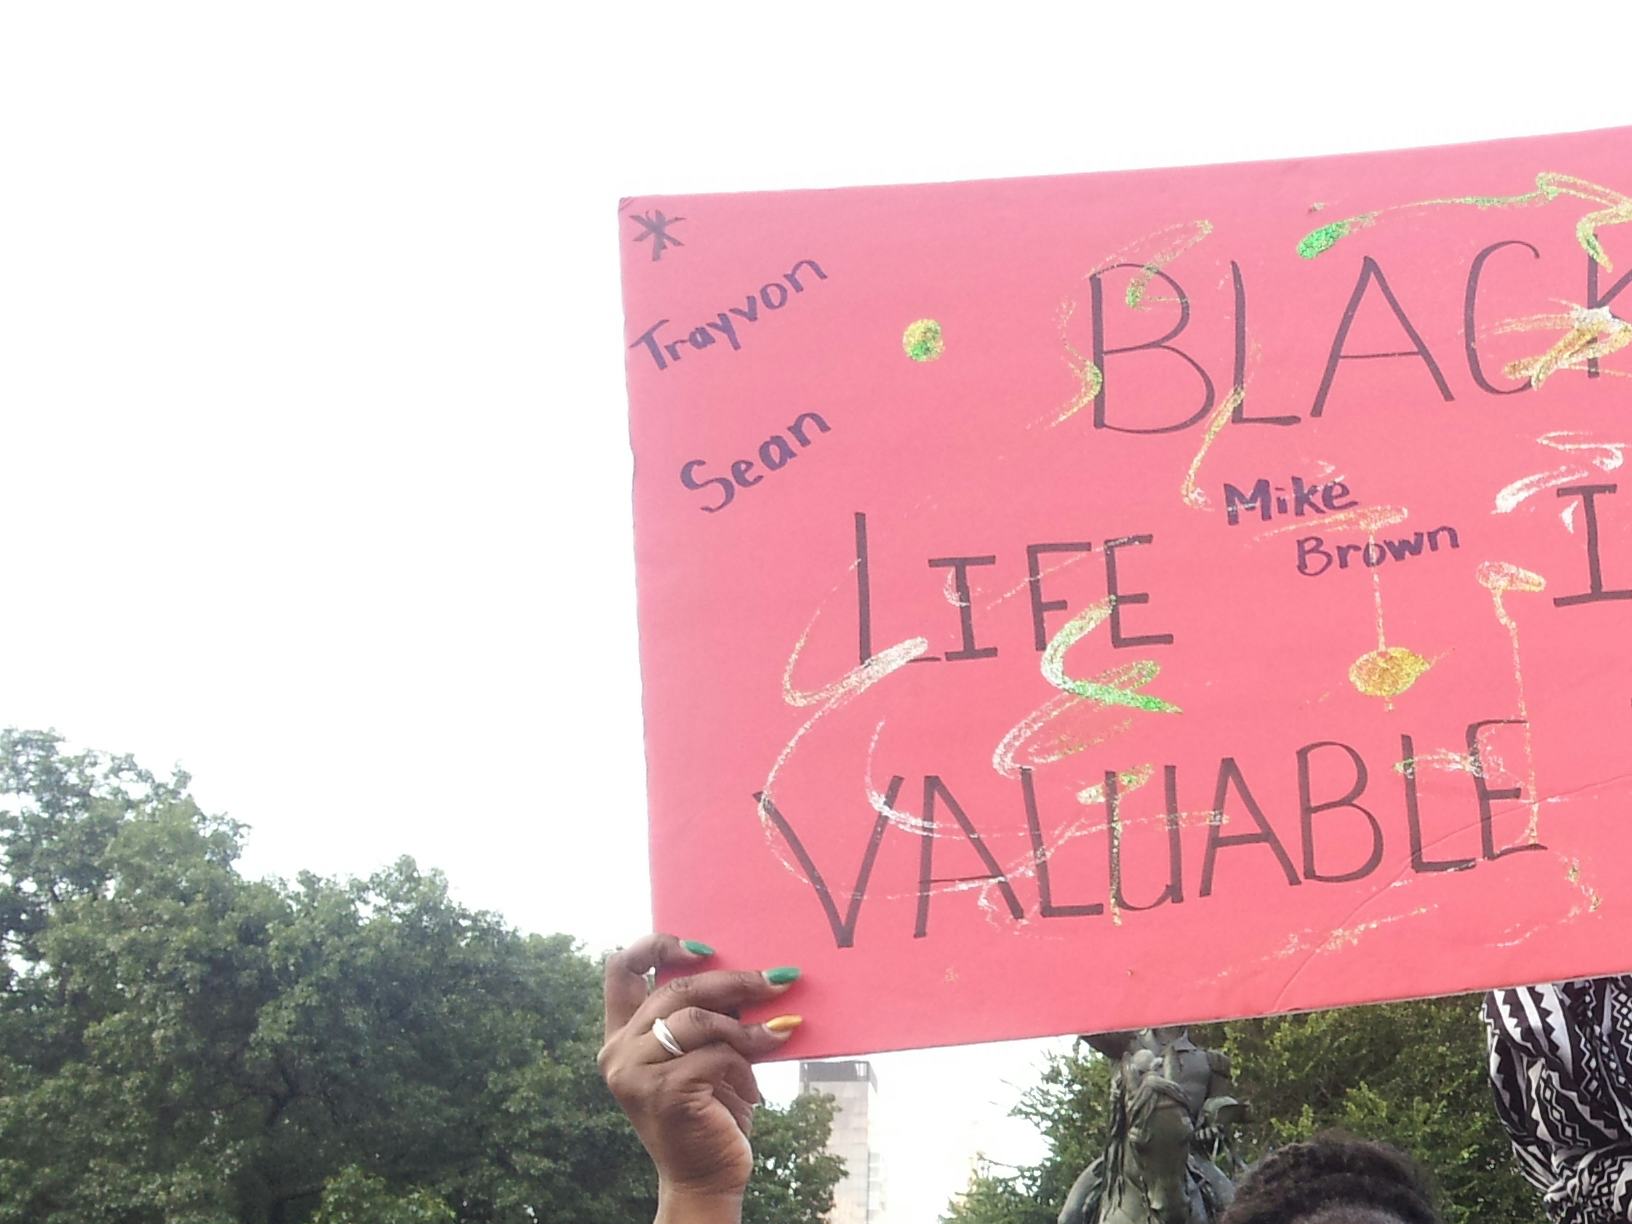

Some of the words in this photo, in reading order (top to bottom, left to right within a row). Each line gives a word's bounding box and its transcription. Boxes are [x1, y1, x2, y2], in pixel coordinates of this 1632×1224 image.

[629, 258, 829, 371] Trayvon
[679, 410, 832, 513] Sean
[1223, 475, 1358, 526] Mike
[853, 510, 1175, 668] LIFE
[1295, 526, 1461, 577] Brown
[751, 718, 1550, 948] VALUABLE
